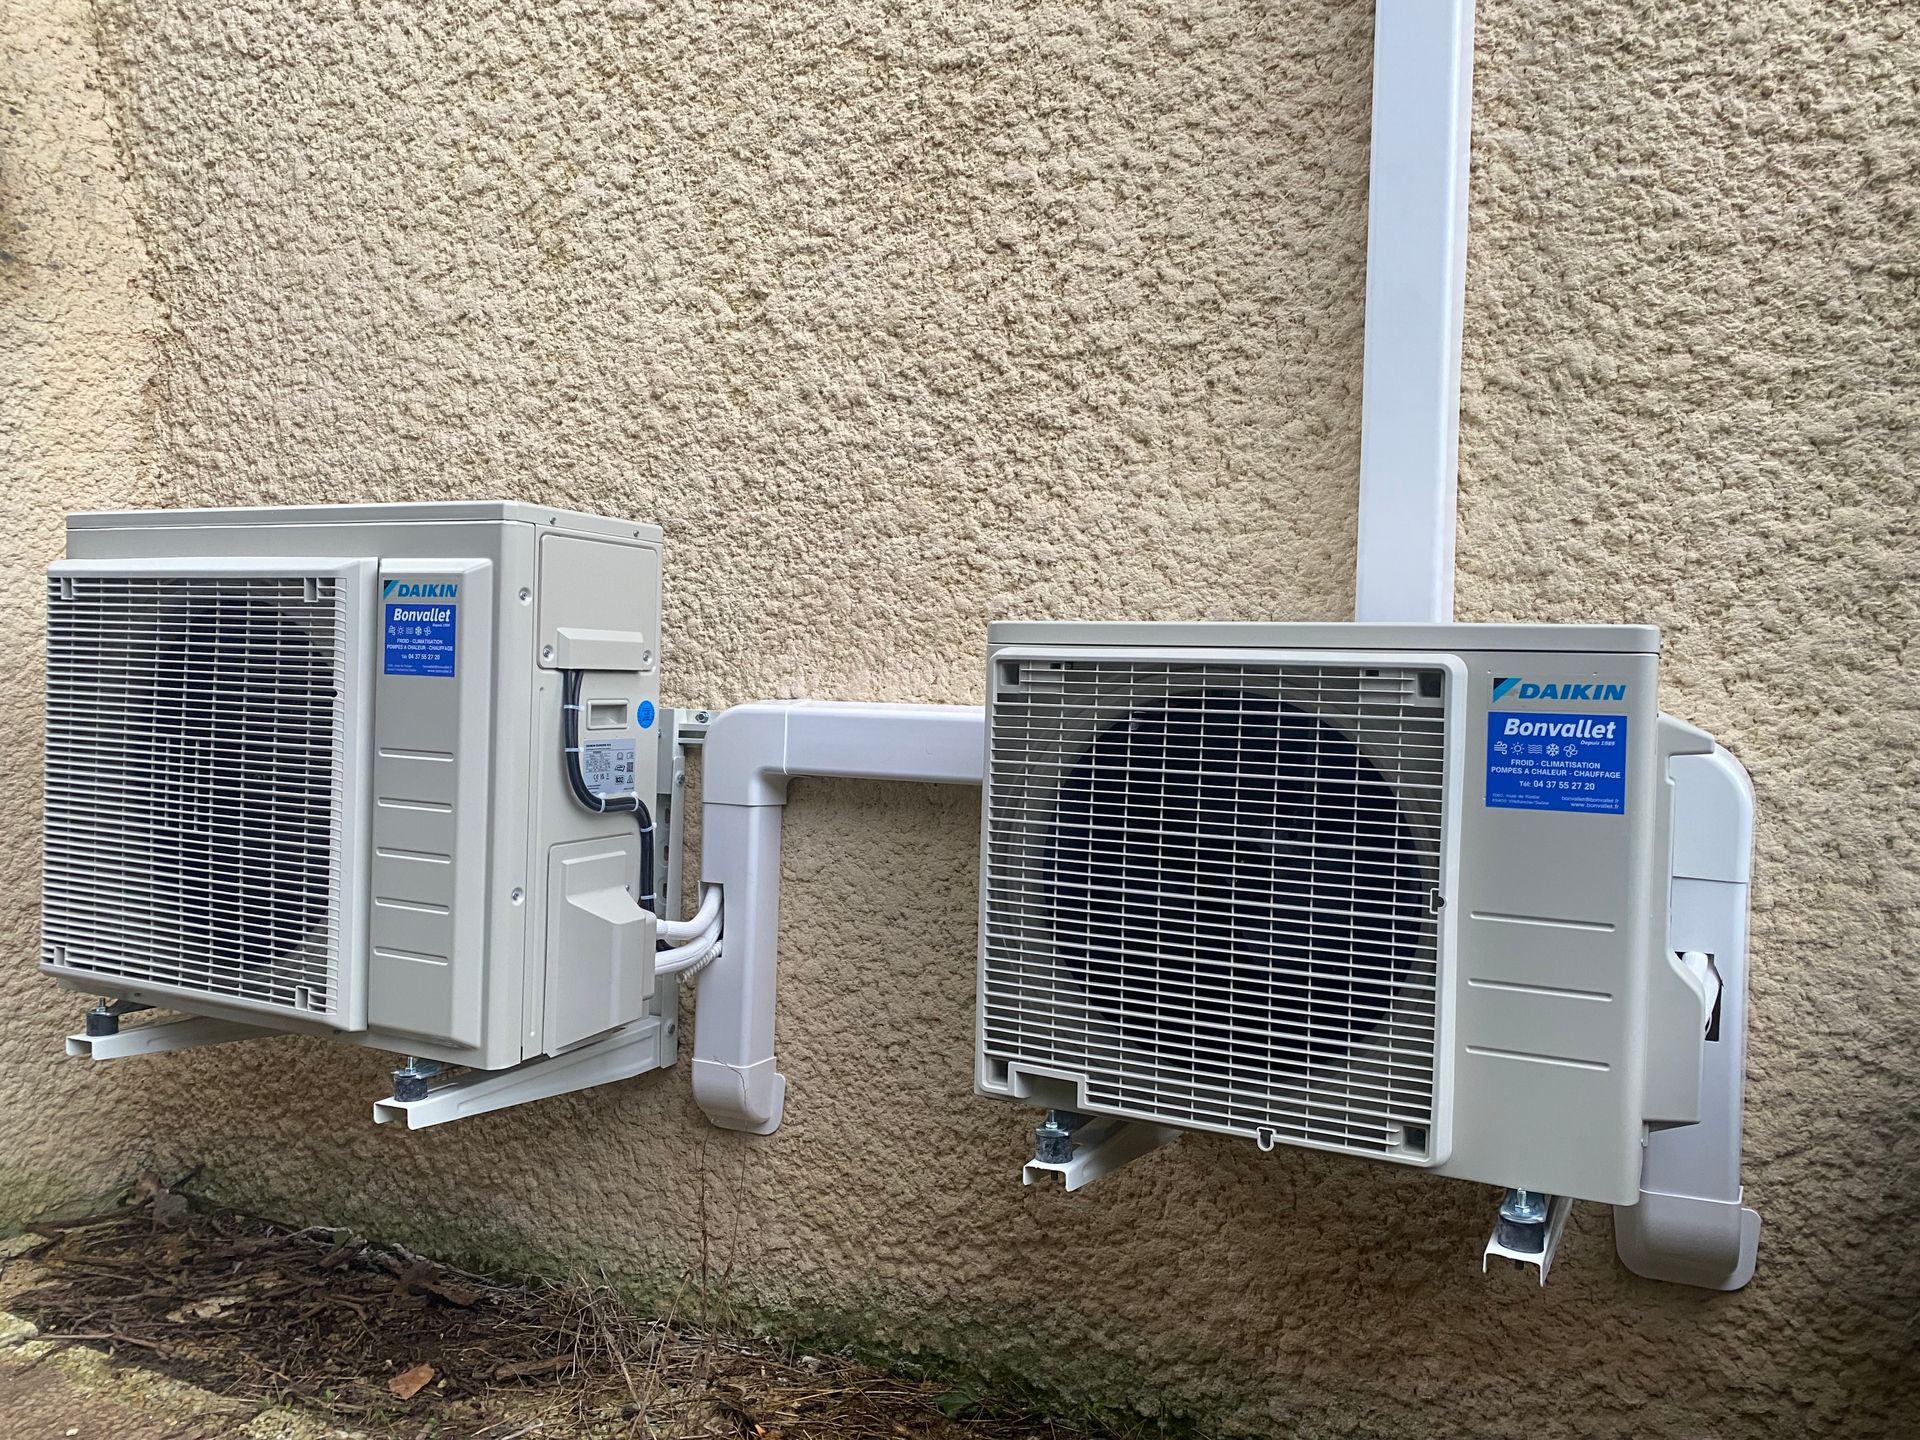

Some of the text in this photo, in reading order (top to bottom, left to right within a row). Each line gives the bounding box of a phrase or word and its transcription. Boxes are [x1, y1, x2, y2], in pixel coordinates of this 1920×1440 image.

[398, 584, 458, 598] DAIKIN
[393, 608, 451, 622] Bonvallet
[1518, 684, 1626, 700] DAIKIN
[1504, 718, 1616, 739] Bonvallet
[1540, 760, 1600, 769] CLIMATISATION
[1490, 766, 1522, 774] POMPES
[1531, 768, 1568, 776] CHALEUR
[1574, 770, 1622, 779] CHAUFFAGE
[1558, 781, 1570, 789] 55
[1571, 782, 1582, 790] 27
